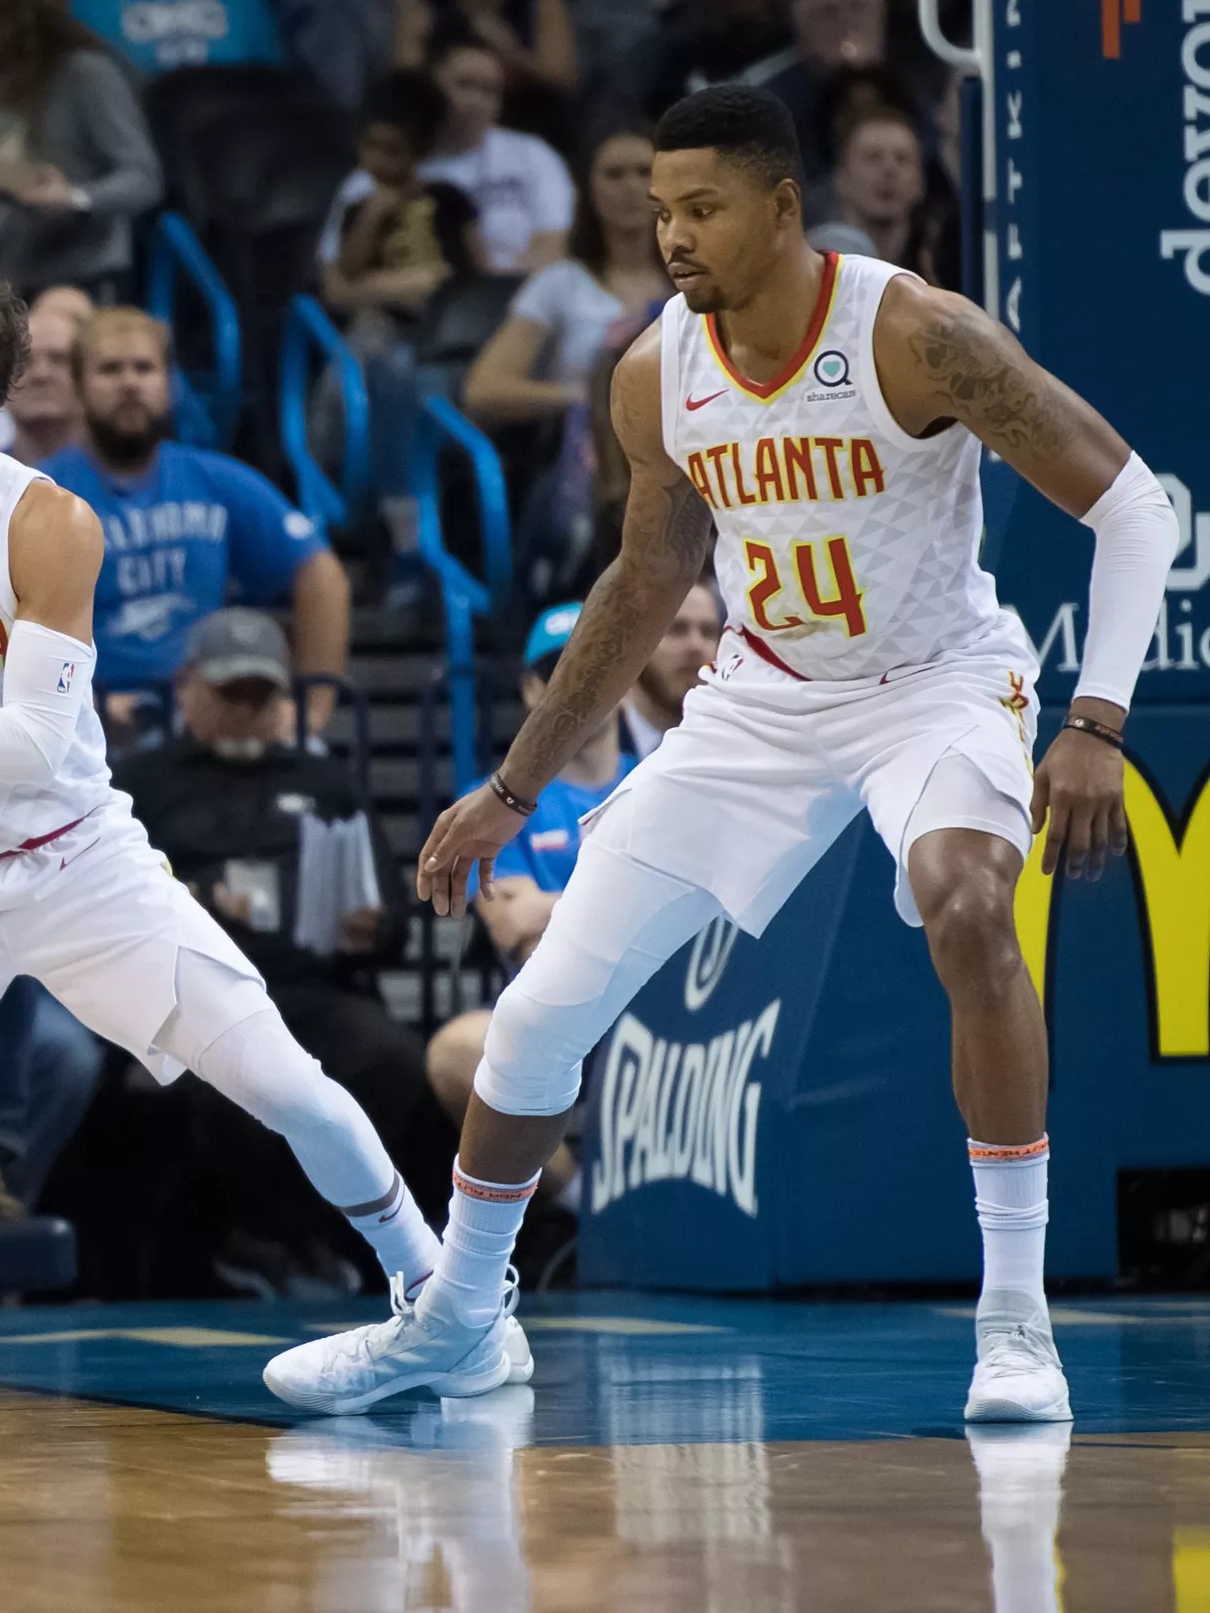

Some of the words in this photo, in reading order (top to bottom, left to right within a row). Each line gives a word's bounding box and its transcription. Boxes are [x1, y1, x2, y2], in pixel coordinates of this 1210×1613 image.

[687, 437, 885, 510] ATLANTA
[742, 535, 867, 638] 24
[591, 997, 781, 1219] SPALDING
